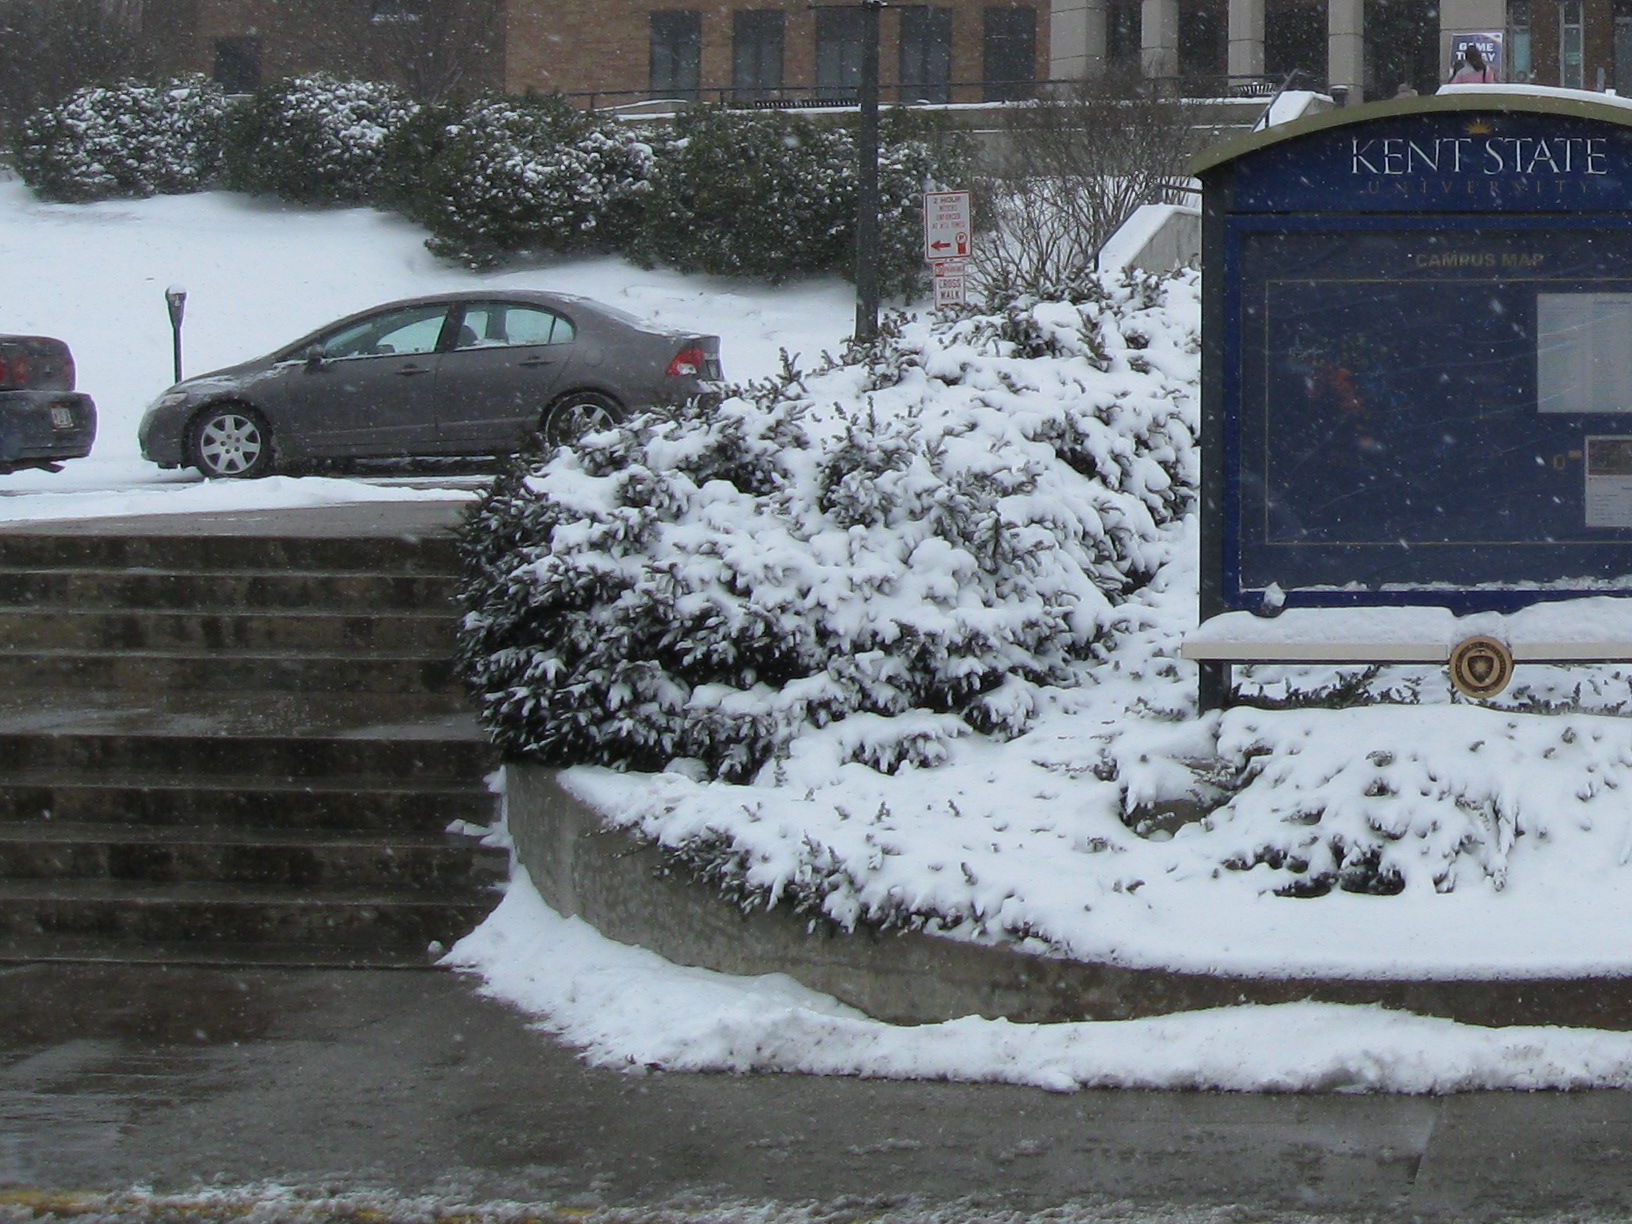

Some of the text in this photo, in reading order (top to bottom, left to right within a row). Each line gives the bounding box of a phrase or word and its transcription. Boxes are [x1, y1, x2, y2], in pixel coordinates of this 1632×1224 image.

[1458, 42, 1494, 51] GME
[1456, 51, 1496, 62] TAY
[1351, 136, 1608, 175] KENT STATE
[1367, 179, 1590, 194] UNIVERSITY
[1415, 253, 1545, 267] CAMPUS MAP
[939, 279, 961, 289] CROSS
[940, 290, 961, 300] WALK
